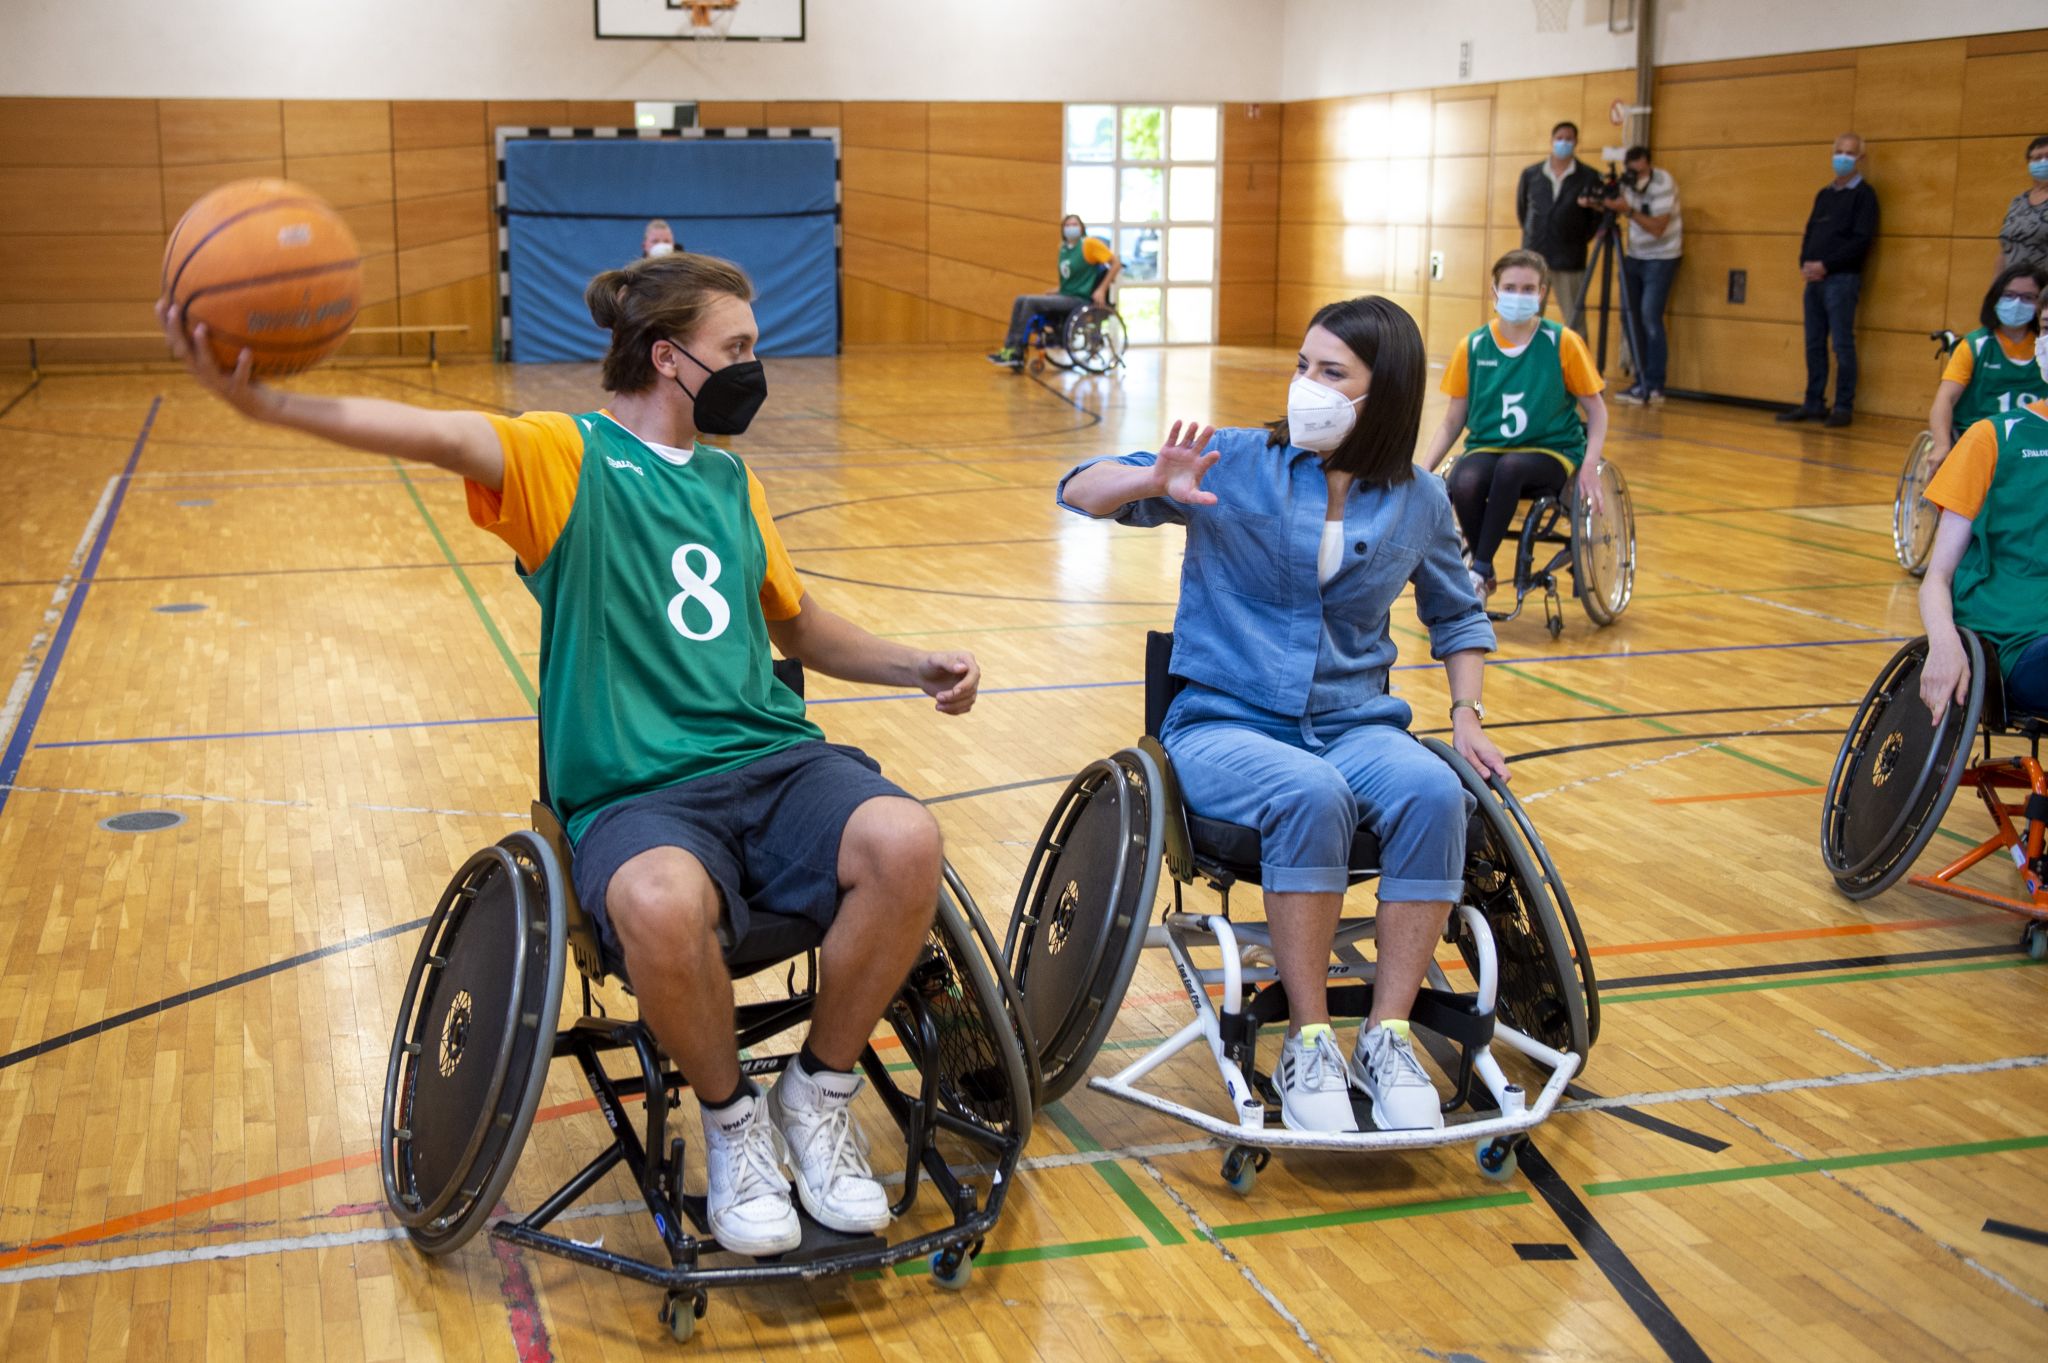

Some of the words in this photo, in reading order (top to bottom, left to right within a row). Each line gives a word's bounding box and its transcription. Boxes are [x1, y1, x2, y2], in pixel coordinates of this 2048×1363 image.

[1499, 391, 1528, 438] 5
[667, 543, 731, 642] 8
[1327, 965, 1350, 974] Pro
[1184, 979, 1196, 994] End
[1191, 995, 1202, 1009] Pro
[753, 1059, 778, 1071] Pro
[605, 1110, 618, 1128] Pro
